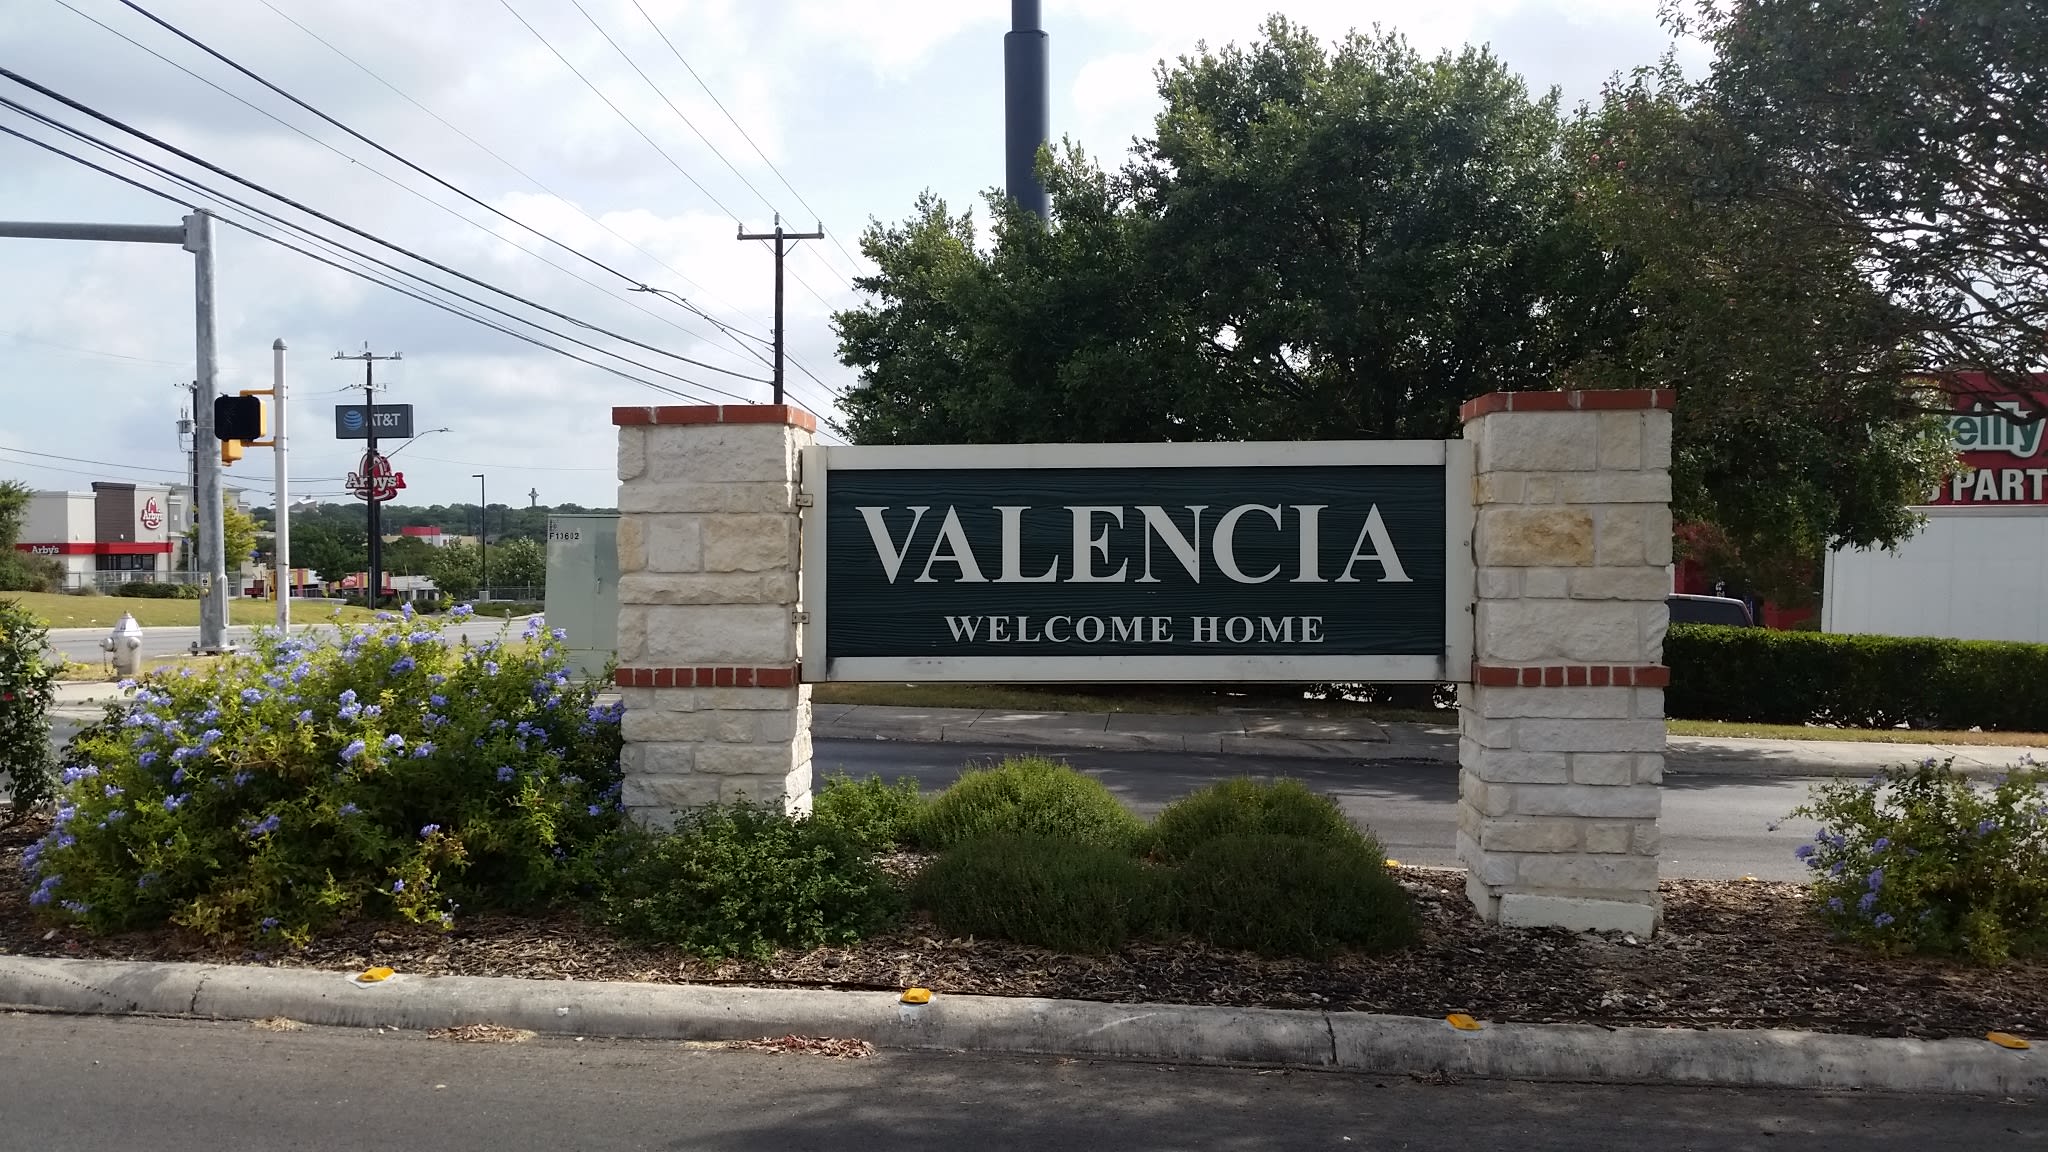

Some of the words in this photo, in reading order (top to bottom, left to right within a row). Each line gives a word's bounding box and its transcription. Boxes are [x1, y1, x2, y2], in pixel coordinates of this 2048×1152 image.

[32, 545, 59, 555] Arby's
[855, 502, 1414, 584] VALENCIA
[944, 615, 1173, 643] WELCOME
[1190, 616, 1325, 643] HOME
